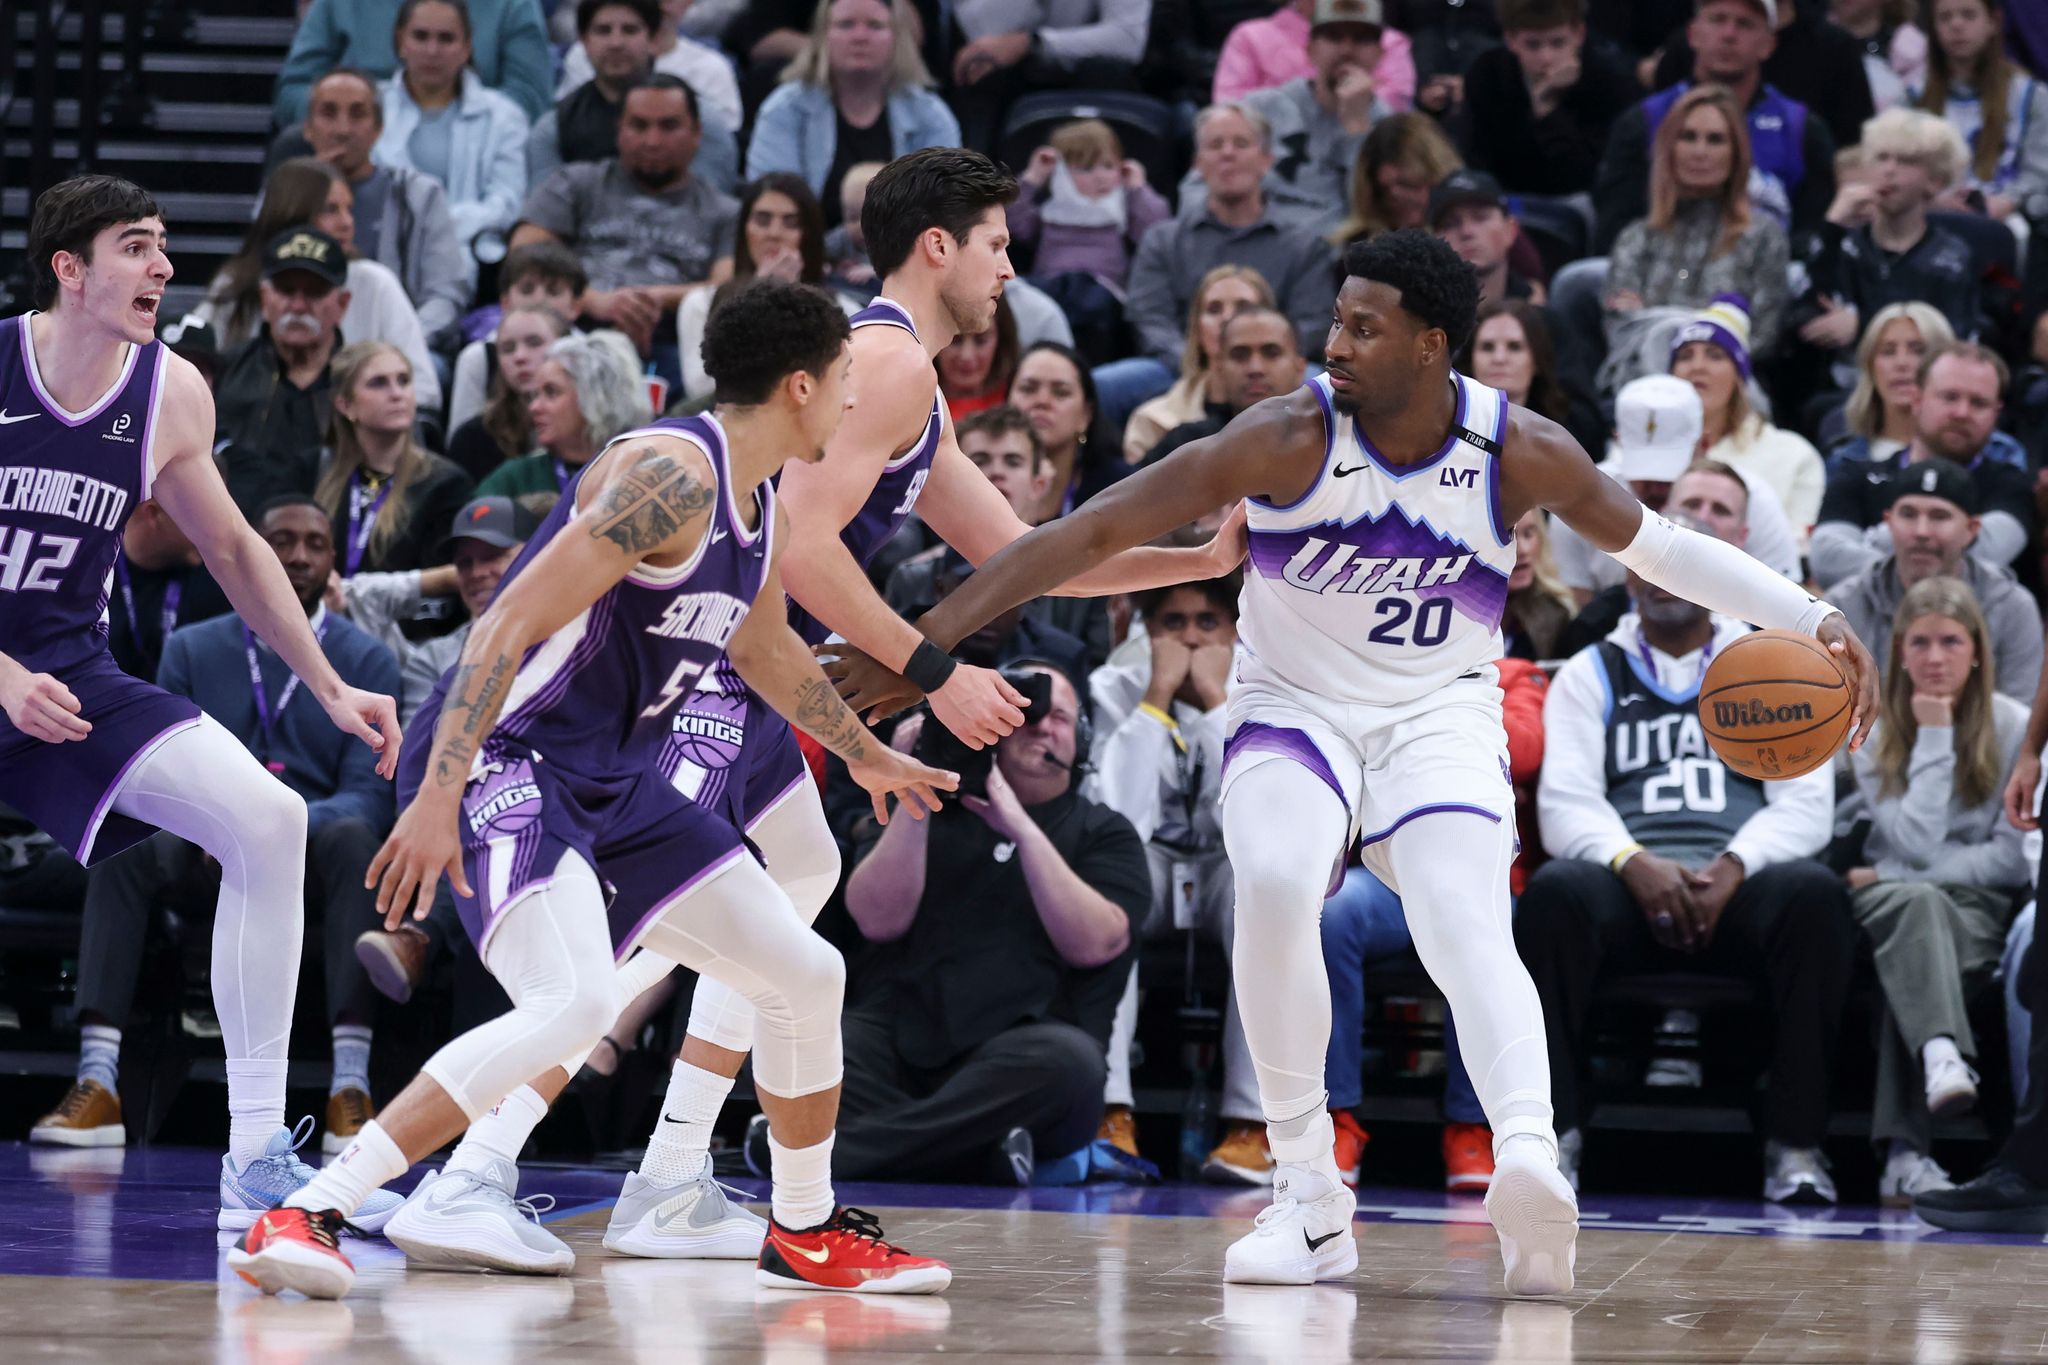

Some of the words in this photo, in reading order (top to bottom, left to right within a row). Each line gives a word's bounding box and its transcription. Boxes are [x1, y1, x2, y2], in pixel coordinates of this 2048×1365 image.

[1465, 432, 1487, 449] FRANK
[1439, 467, 1480, 489] LVT
[0, 524, 82, 593] 42
[1281, 536, 1479, 595] UTAH
[1367, 597, 1453, 646] 20
[640, 659, 704, 719] 5
[1714, 698, 1814, 728] Wilson
[672, 714, 744, 747] KINGS
[1616, 713, 1718, 773] UTA
[470, 784, 542, 833] KINGS
[1642, 758, 1727, 814] 20
